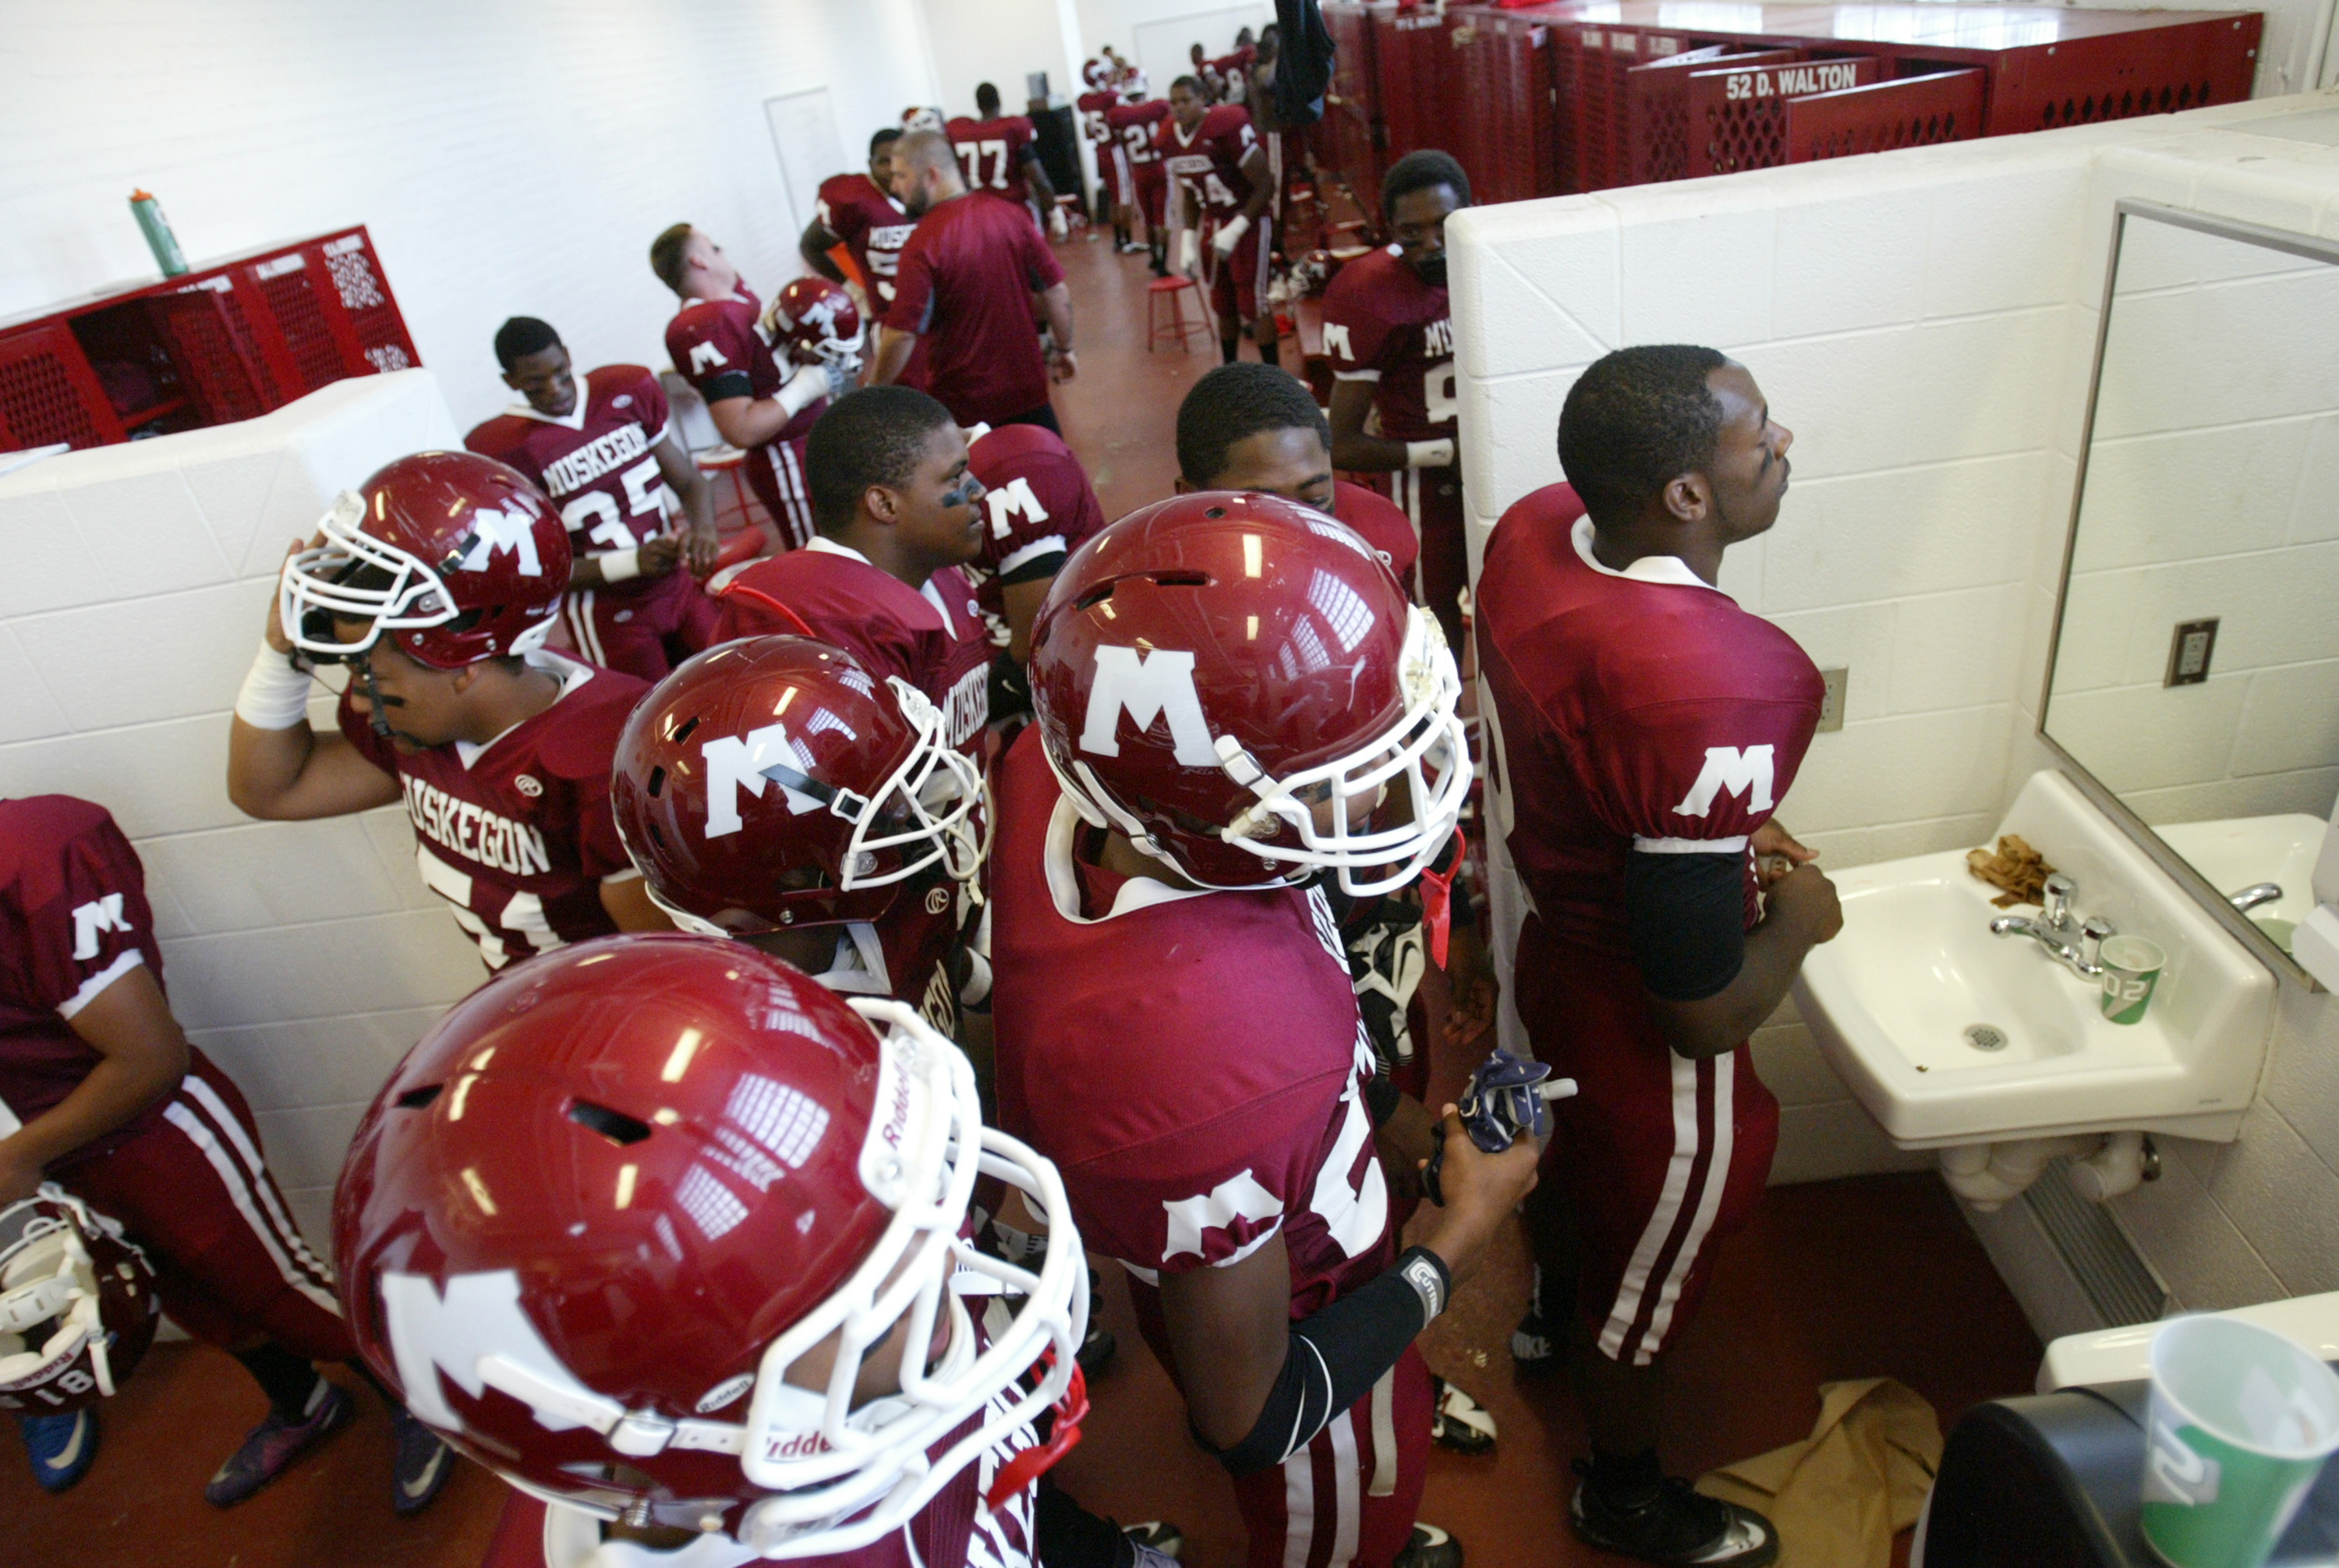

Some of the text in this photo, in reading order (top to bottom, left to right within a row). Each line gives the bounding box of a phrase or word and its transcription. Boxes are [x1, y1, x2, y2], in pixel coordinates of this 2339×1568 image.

[1726, 63, 1857, 100] 52 D. WALTON
[955, 139, 1008, 189] 77
[689, 341, 728, 376] M
[1322, 322, 1355, 361] M
[542, 420, 649, 499] MUSKEGON
[561, 455, 663, 549] 35
[986, 477, 1049, 540] M
[461, 508, 543, 577] M
[1079, 644, 1224, 767] M
[702, 722, 826, 839] M
[1672, 744, 1775, 819] M
[72, 892, 133, 960] M
[1162, 1168, 1284, 1263] M
[380, 1269, 627, 1433] M
[765, 1430, 833, 1458] idde
